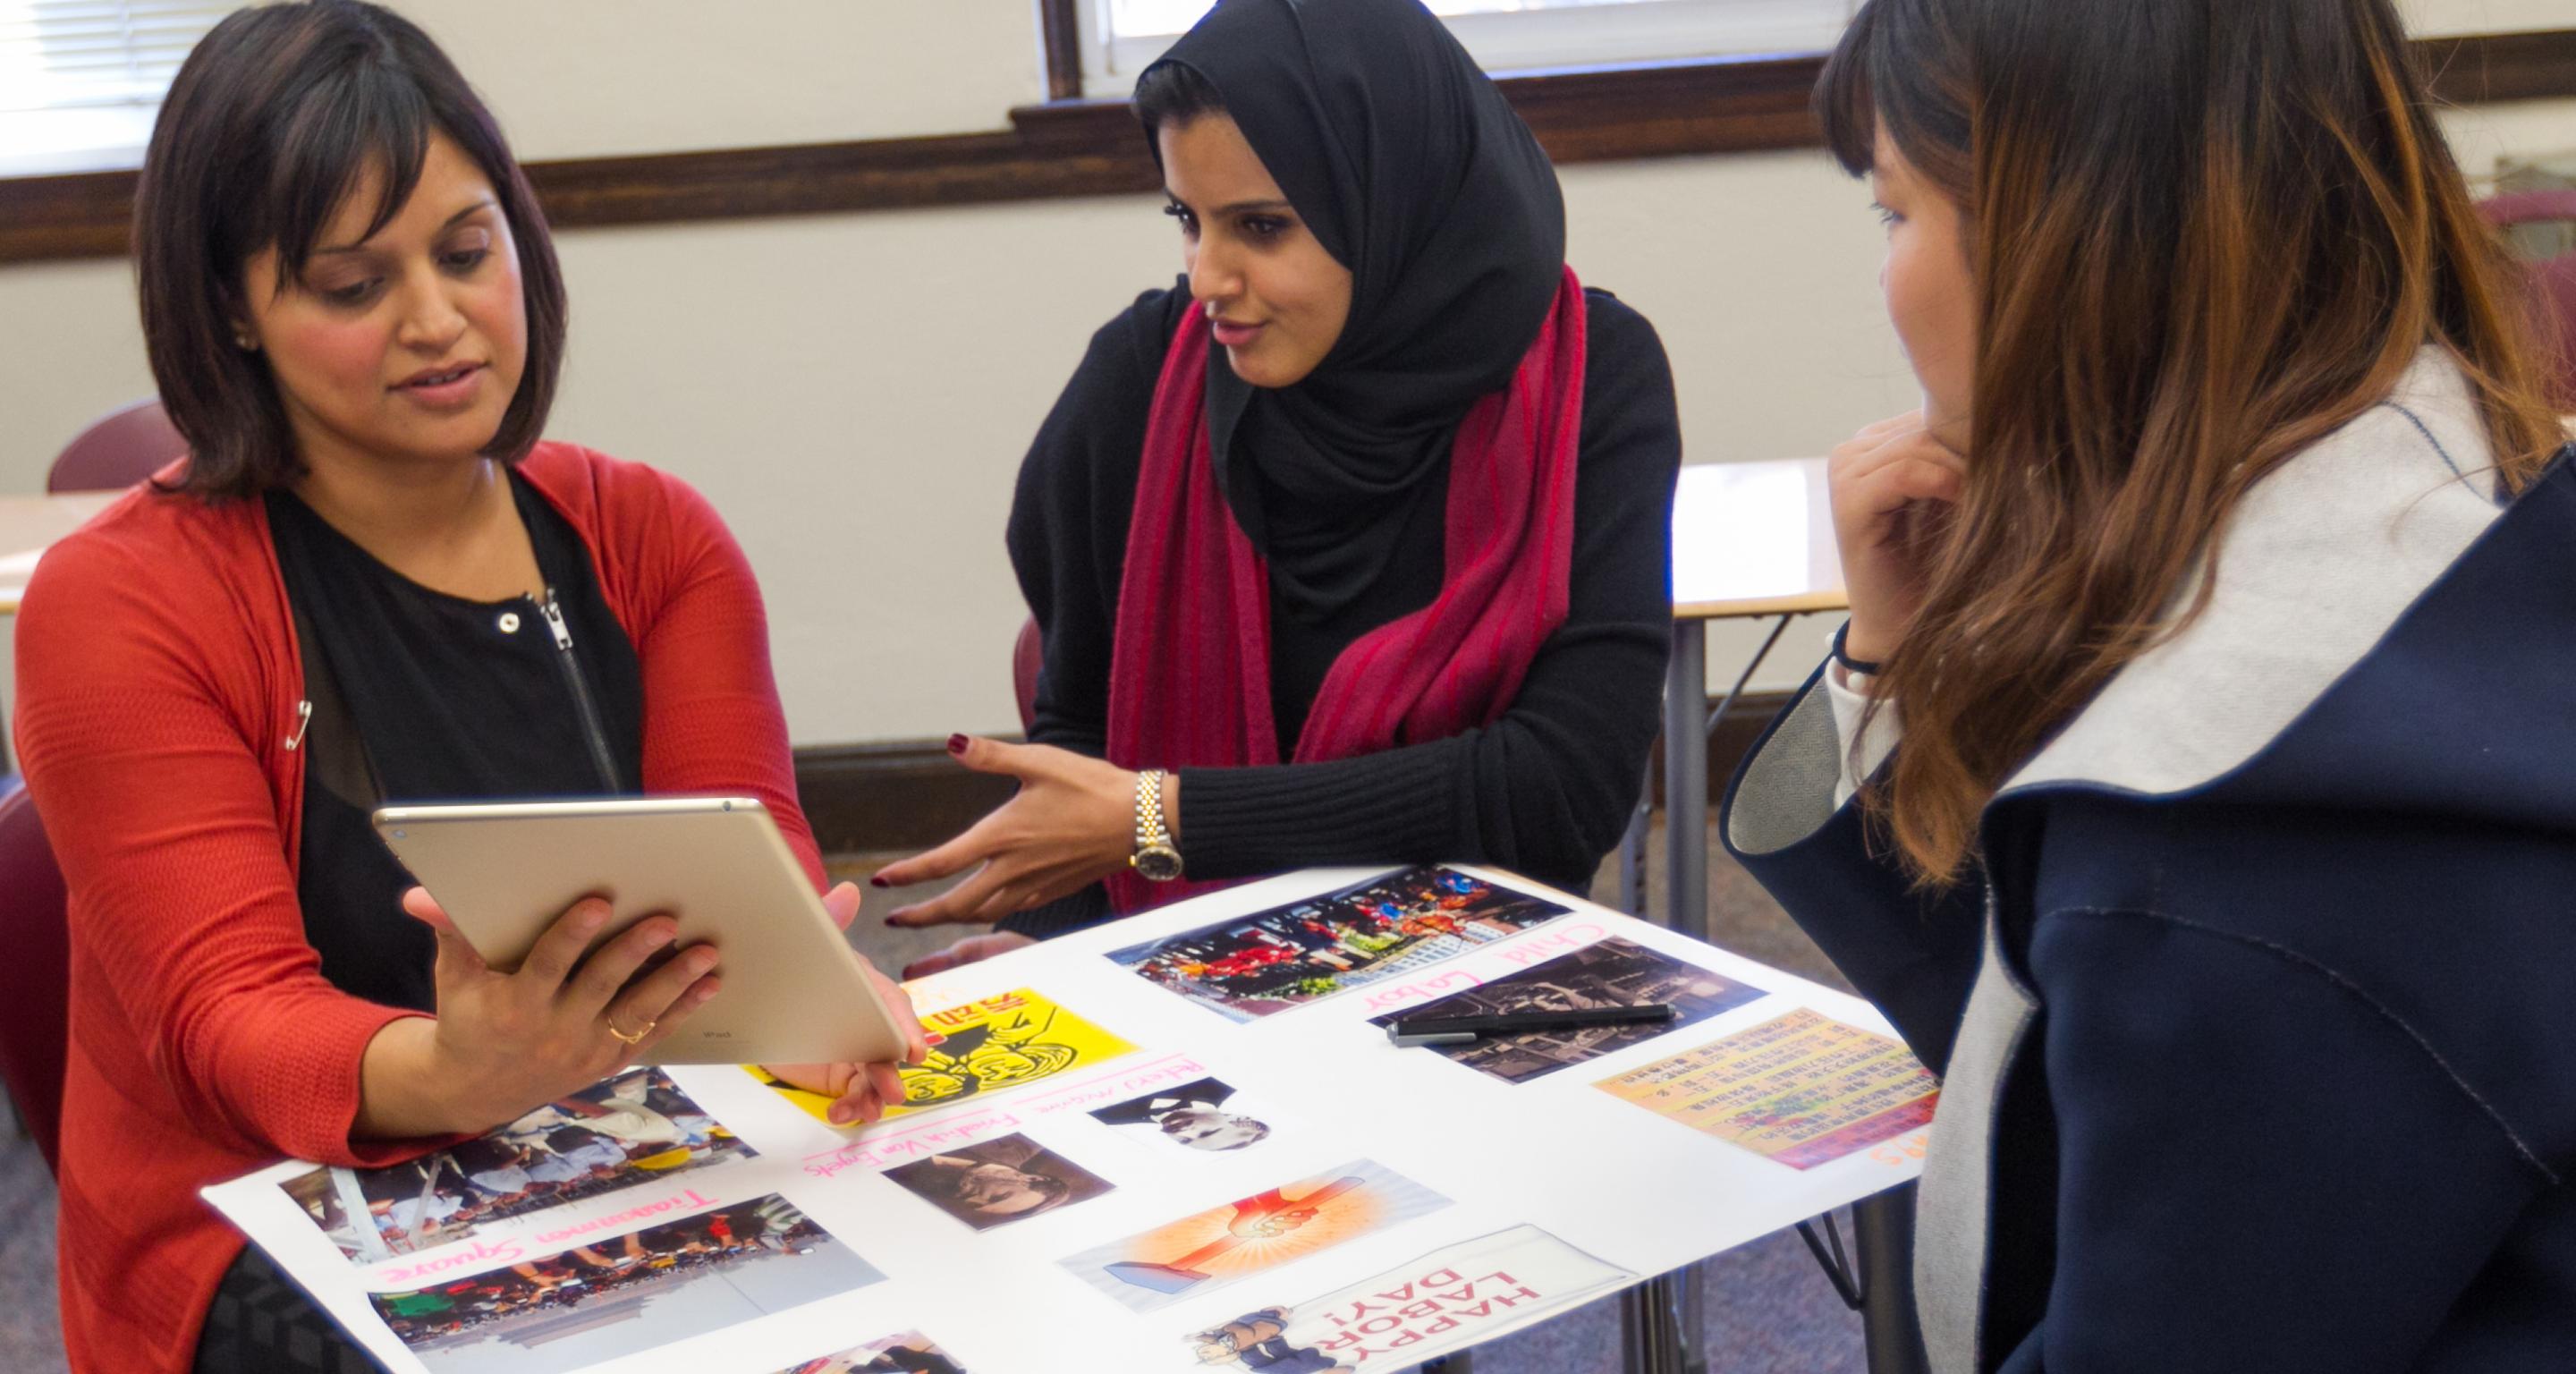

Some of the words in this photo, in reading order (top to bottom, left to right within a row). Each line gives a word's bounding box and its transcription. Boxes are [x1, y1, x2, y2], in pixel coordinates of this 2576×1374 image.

[1503, 924, 1604, 965] Child
[925, 993, 1029, 1029] 劳动
[1365, 970, 1484, 1011] Labor
[702, 1030, 732, 1039] iPad
[538, 1189, 719, 1244] Tiananmen
[379, 1237, 525, 1284] Square
[1315, 1271, 1518, 1351] LABOR
[1322, 1268, 1464, 1327] DAY!
[1352, 1286, 1541, 1362] HAPPY
